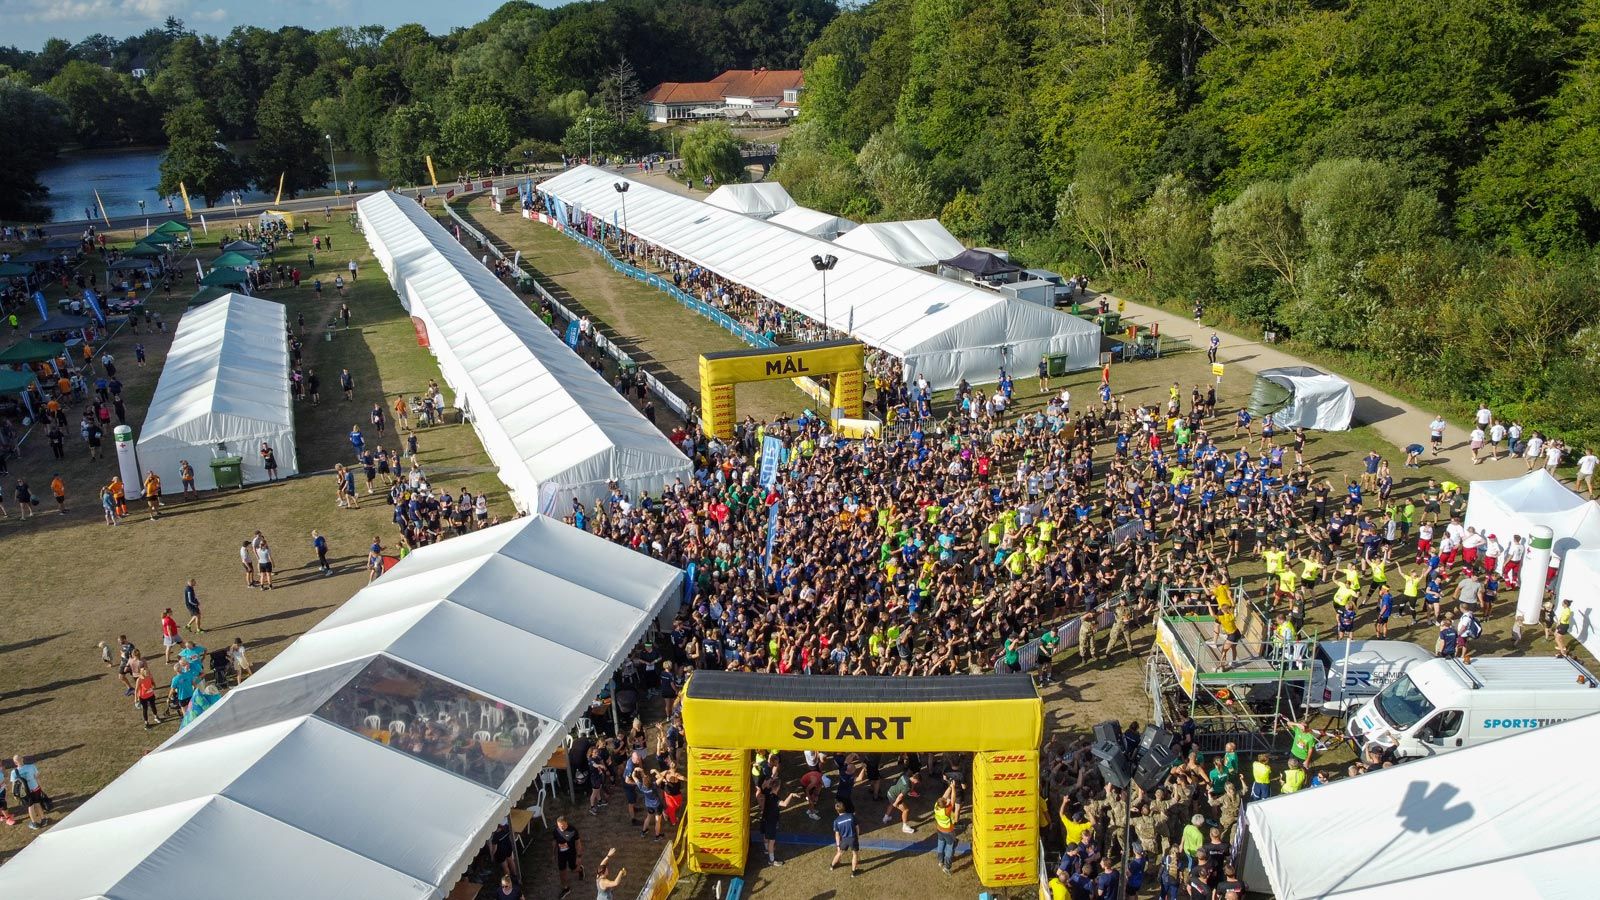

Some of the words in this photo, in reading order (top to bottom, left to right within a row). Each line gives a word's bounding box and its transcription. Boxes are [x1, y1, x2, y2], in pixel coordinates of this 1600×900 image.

[766, 355, 809, 375] MÅL
[1345, 670, 1371, 686] SR
[792, 716, 912, 740] START
[993, 772, 1027, 780] DHL
[993, 823, 1027, 831] DHL
[993, 840, 1027, 848] DHL
[993, 856, 1027, 864] DHL
[993, 872, 1027, 880] DHL
